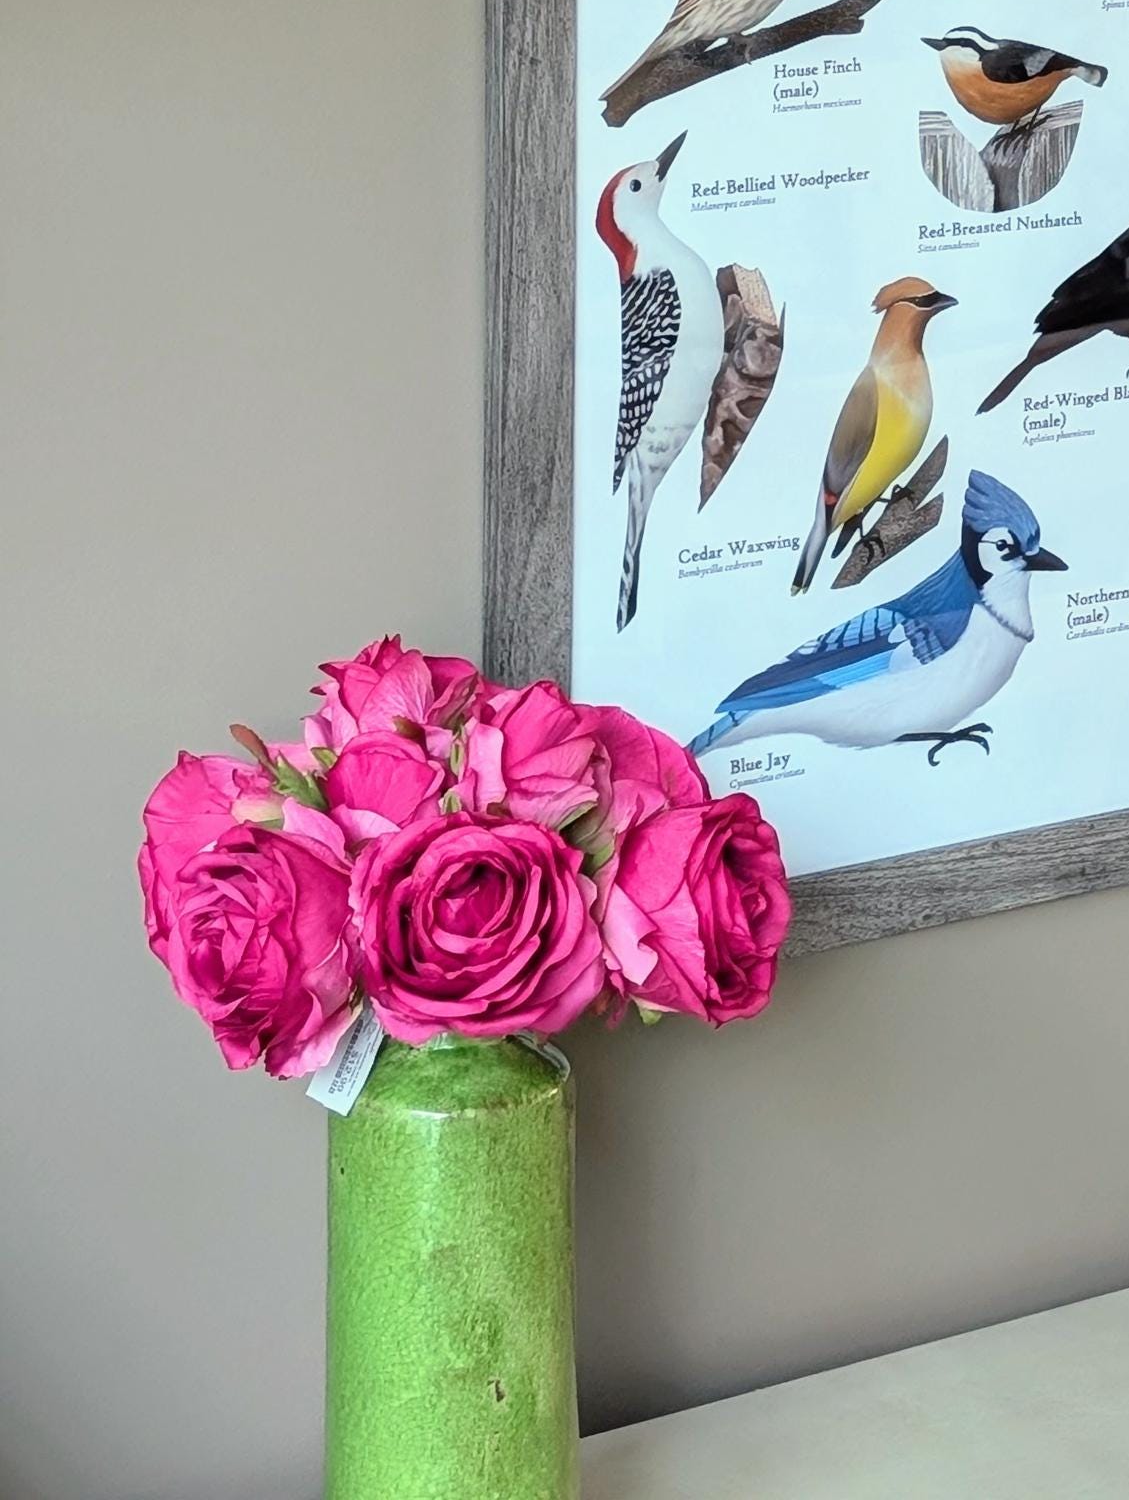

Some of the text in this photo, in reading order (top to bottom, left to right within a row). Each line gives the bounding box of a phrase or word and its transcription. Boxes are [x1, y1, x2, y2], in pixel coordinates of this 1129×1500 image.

[773, 57, 861, 79] House Finch
[773, 79, 819, 99] (male)
[691, 167, 870, 198] Red-Bellied Woodpecker
[918, 210, 1082, 239] Red-Breasted Nuthatch
[1023, 387, 1109, 412] Red-Winged
[1023, 411, 1067, 431] (male)
[678, 535, 800, 564] Cedar Waxwing
[1067, 587, 1129, 607] Northern
[1066, 605, 1109, 628] (male)
[730, 753, 791, 775] Blue Jay
